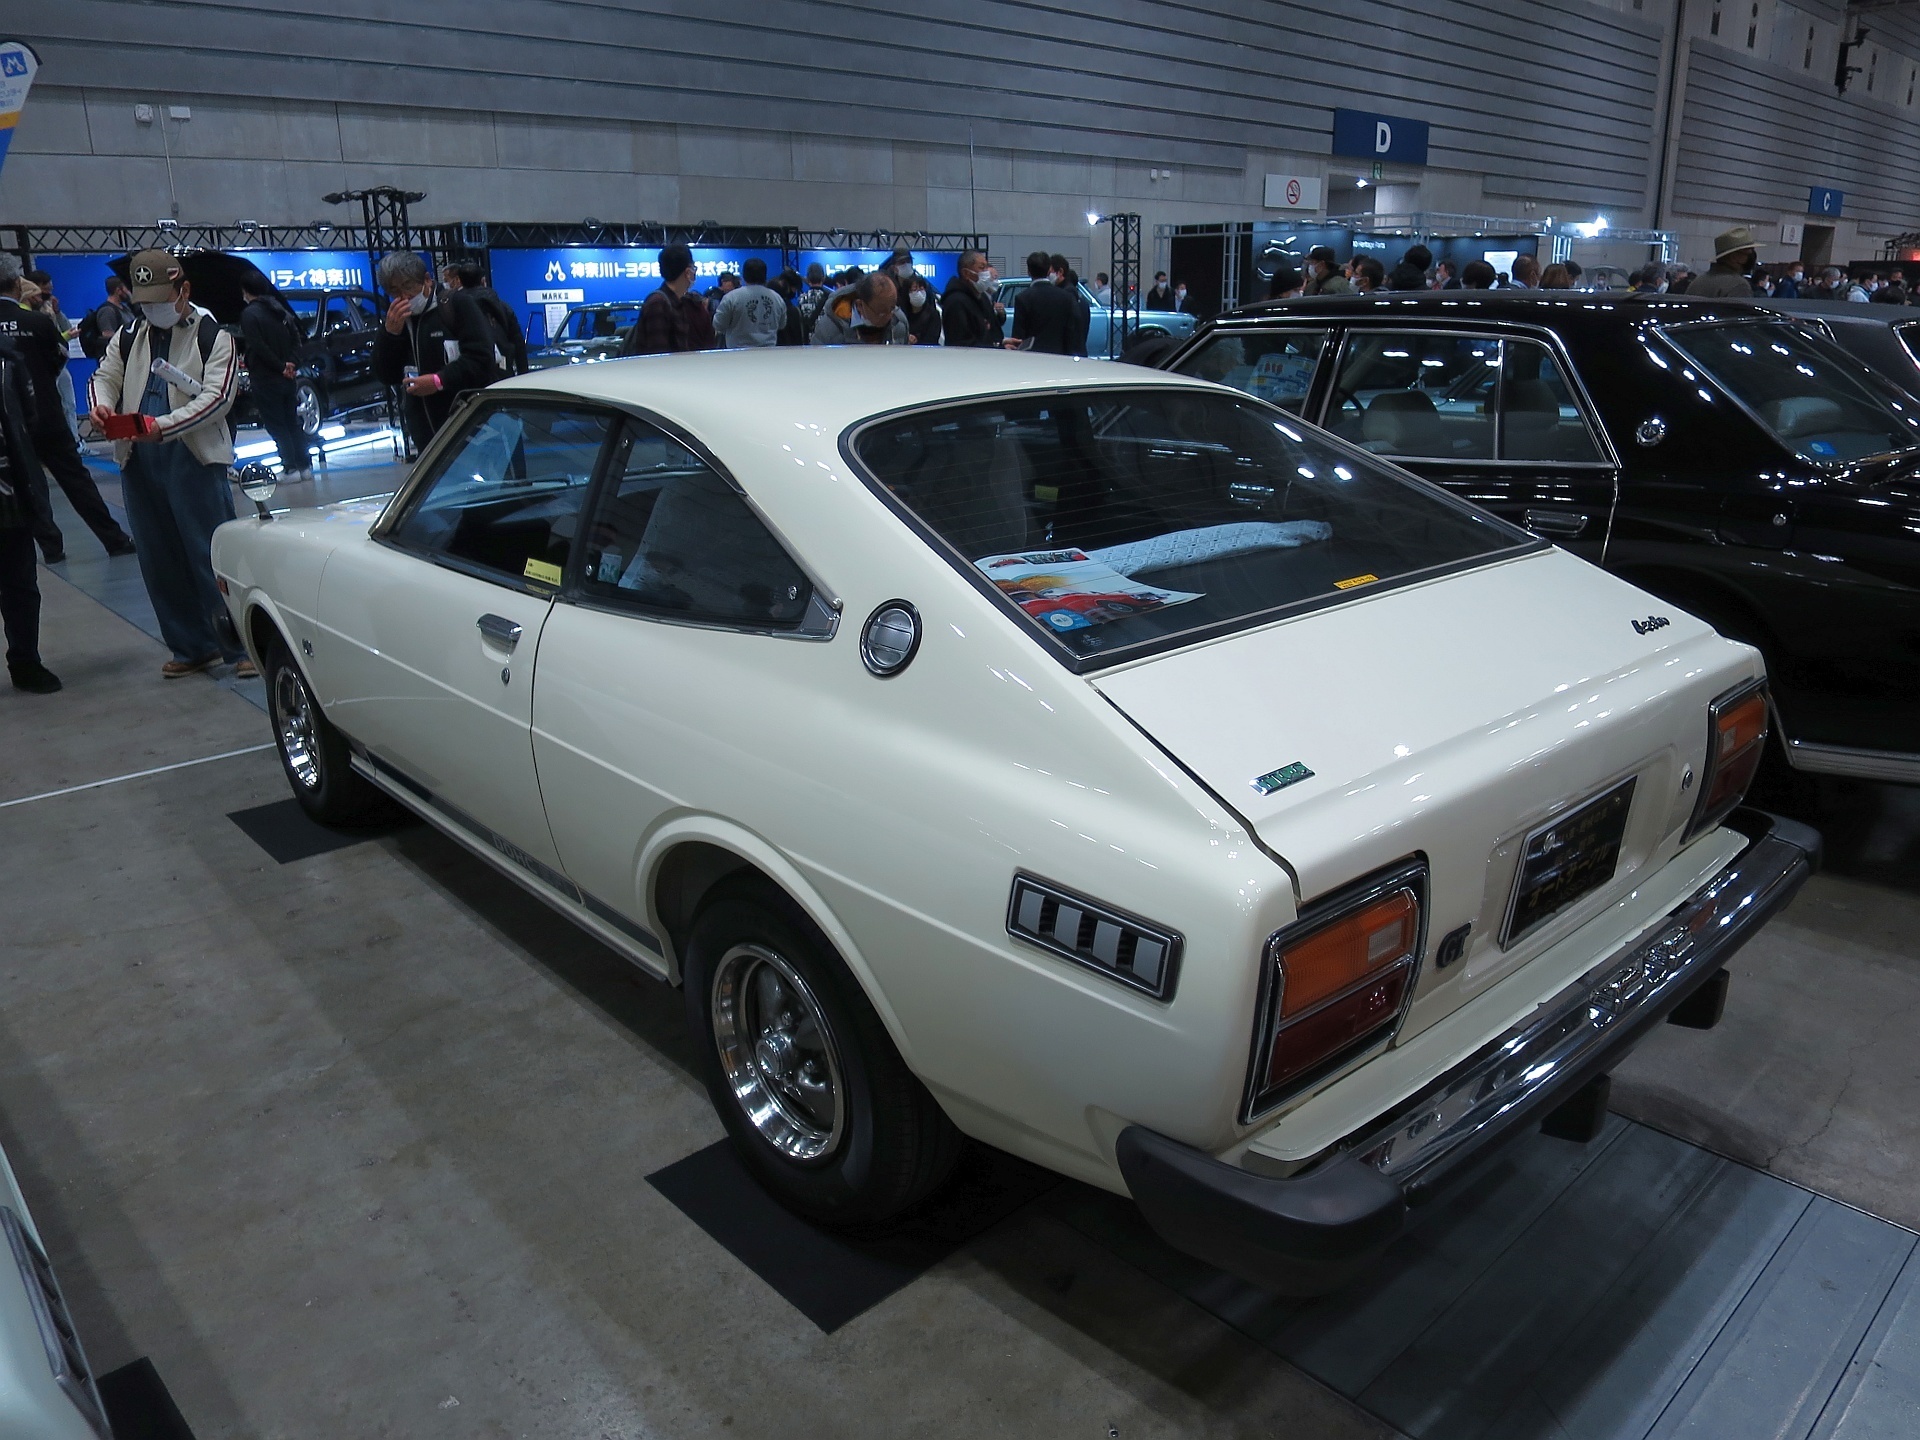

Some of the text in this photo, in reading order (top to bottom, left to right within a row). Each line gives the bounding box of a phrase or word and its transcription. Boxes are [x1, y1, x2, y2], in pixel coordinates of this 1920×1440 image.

[1376, 121, 1392, 153] D
[1823, 192, 1832, 211] C
[570, 261, 740, 278] 神奈川トヨタ自株式会社
[541, 292, 562, 300] MARK
[1435, 922, 1471, 968] GT
